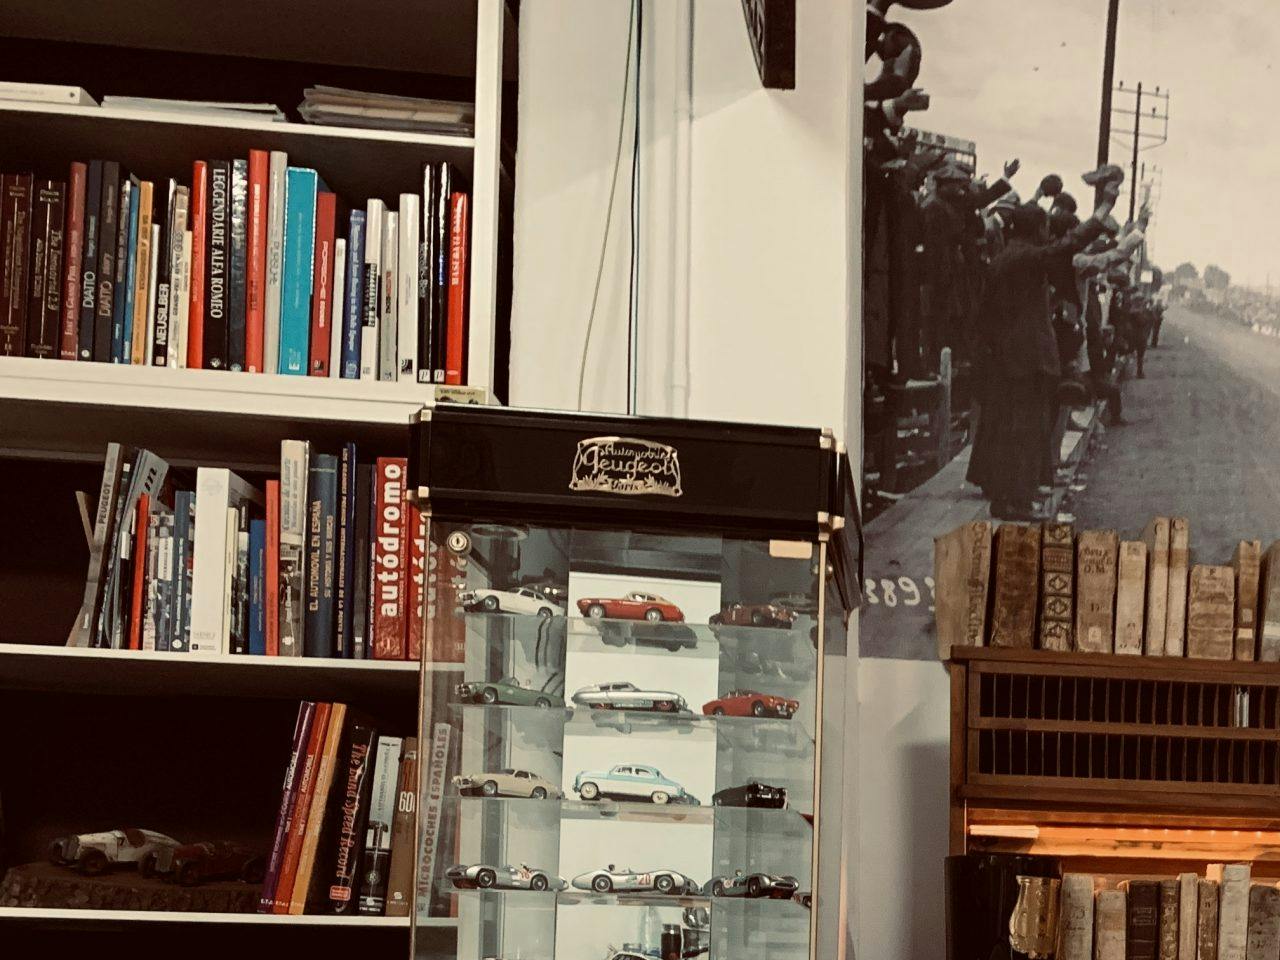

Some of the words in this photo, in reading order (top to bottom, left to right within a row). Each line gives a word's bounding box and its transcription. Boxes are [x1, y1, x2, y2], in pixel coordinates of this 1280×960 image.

[211, 169, 226, 246] LEGGENDARIE
[211, 247, 224, 275] ALFA
[155, 283, 169, 345] NEUSILBER
[210, 277, 224, 318] ROMEO
[98, 482, 112, 525] PEUGEOT
[311, 535, 320, 547] EN
[377, 464, 401, 617] autódromo
[310, 549, 320, 597] AUTOMOVIL
[309, 600, 318, 611] EL
[351, 743, 367, 765] The
[342, 800, 359, 835] Speed
[399, 790, 416, 813] 60
[335, 837, 354, 879] Record
[419, 806, 437, 897] MICROCOCHES
[637, 873, 651, 885] 20
